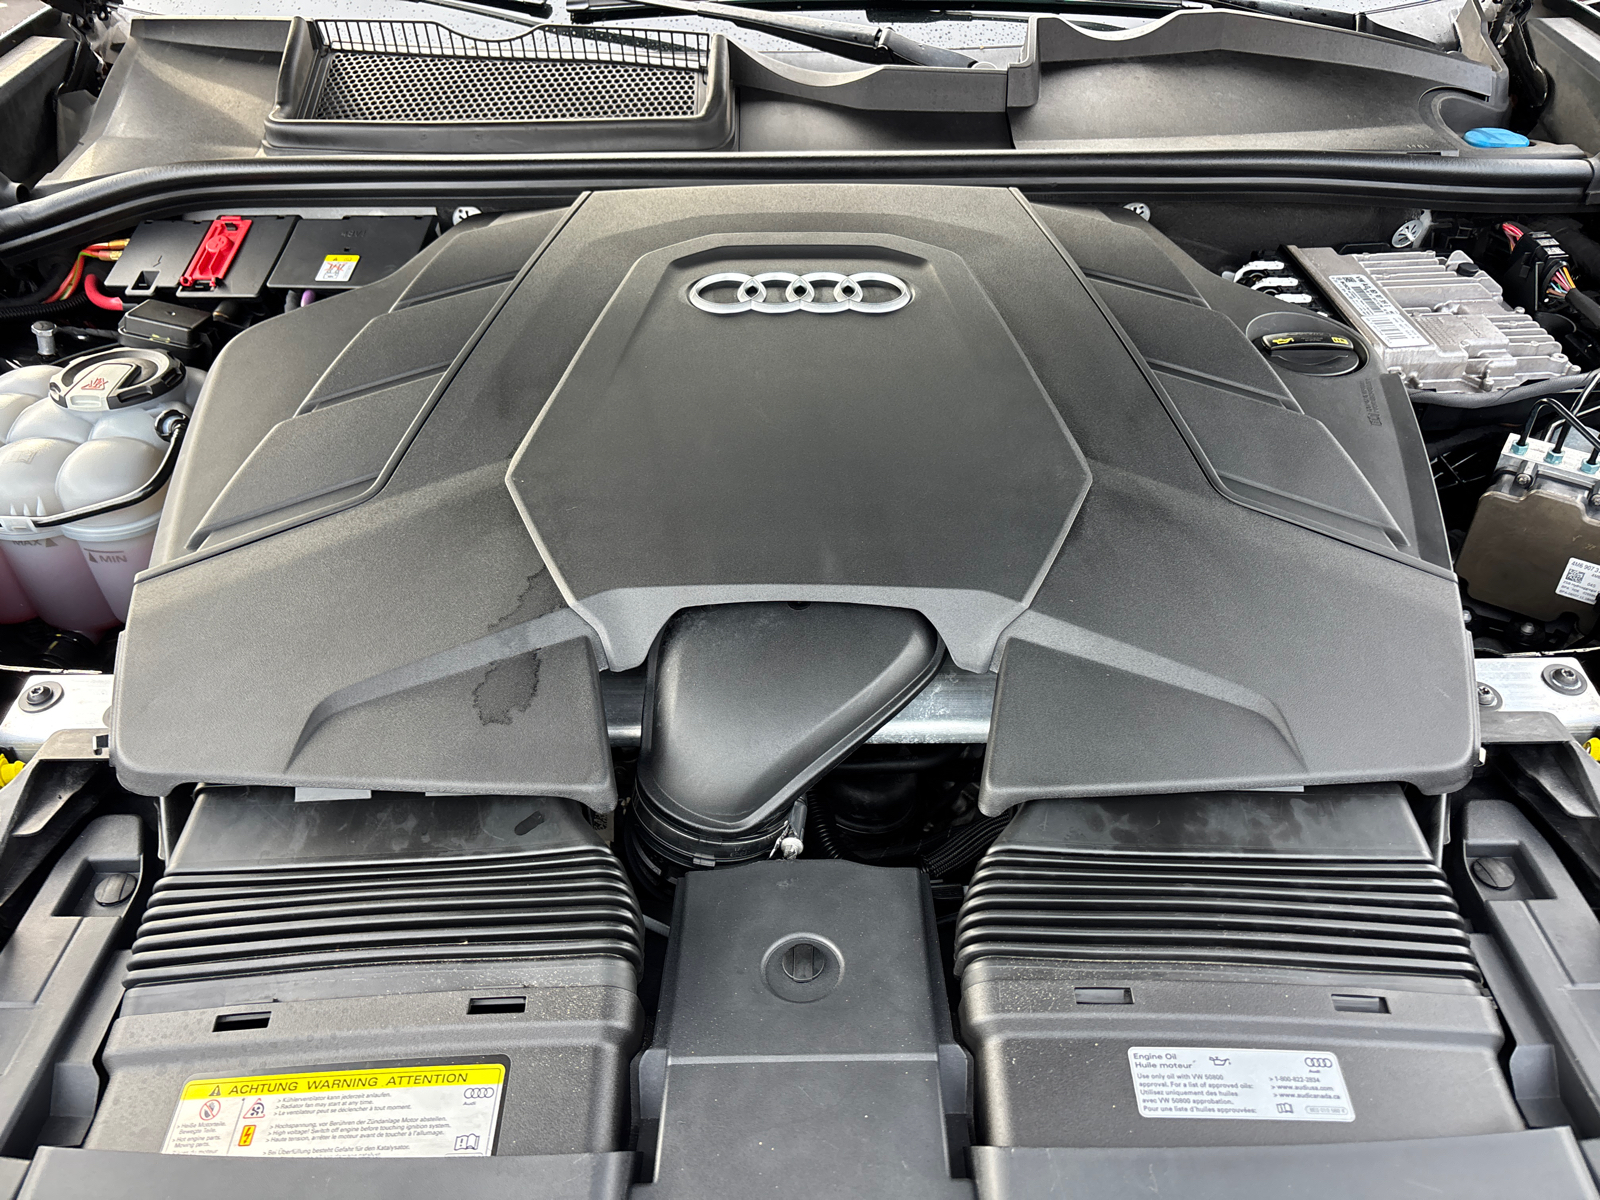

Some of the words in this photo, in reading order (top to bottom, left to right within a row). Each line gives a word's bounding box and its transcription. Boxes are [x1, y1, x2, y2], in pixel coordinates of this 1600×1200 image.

[99, 555, 127, 563] MIN
[228, 1082, 298, 1095] ACHTUNG
[306, 1077, 378, 1090] WARNING
[386, 1073, 468, 1086] ATTENTION
[367, 1118, 400, 1126] Zündanlage
[287, 1128, 311, 1136] voltage!
[379, 1124, 406, 1132] touching
[406, 1123, 428, 1131] ignition
[429, 1122, 452, 1130] system.
[376, 1144, 410, 1152] Katalysator.
